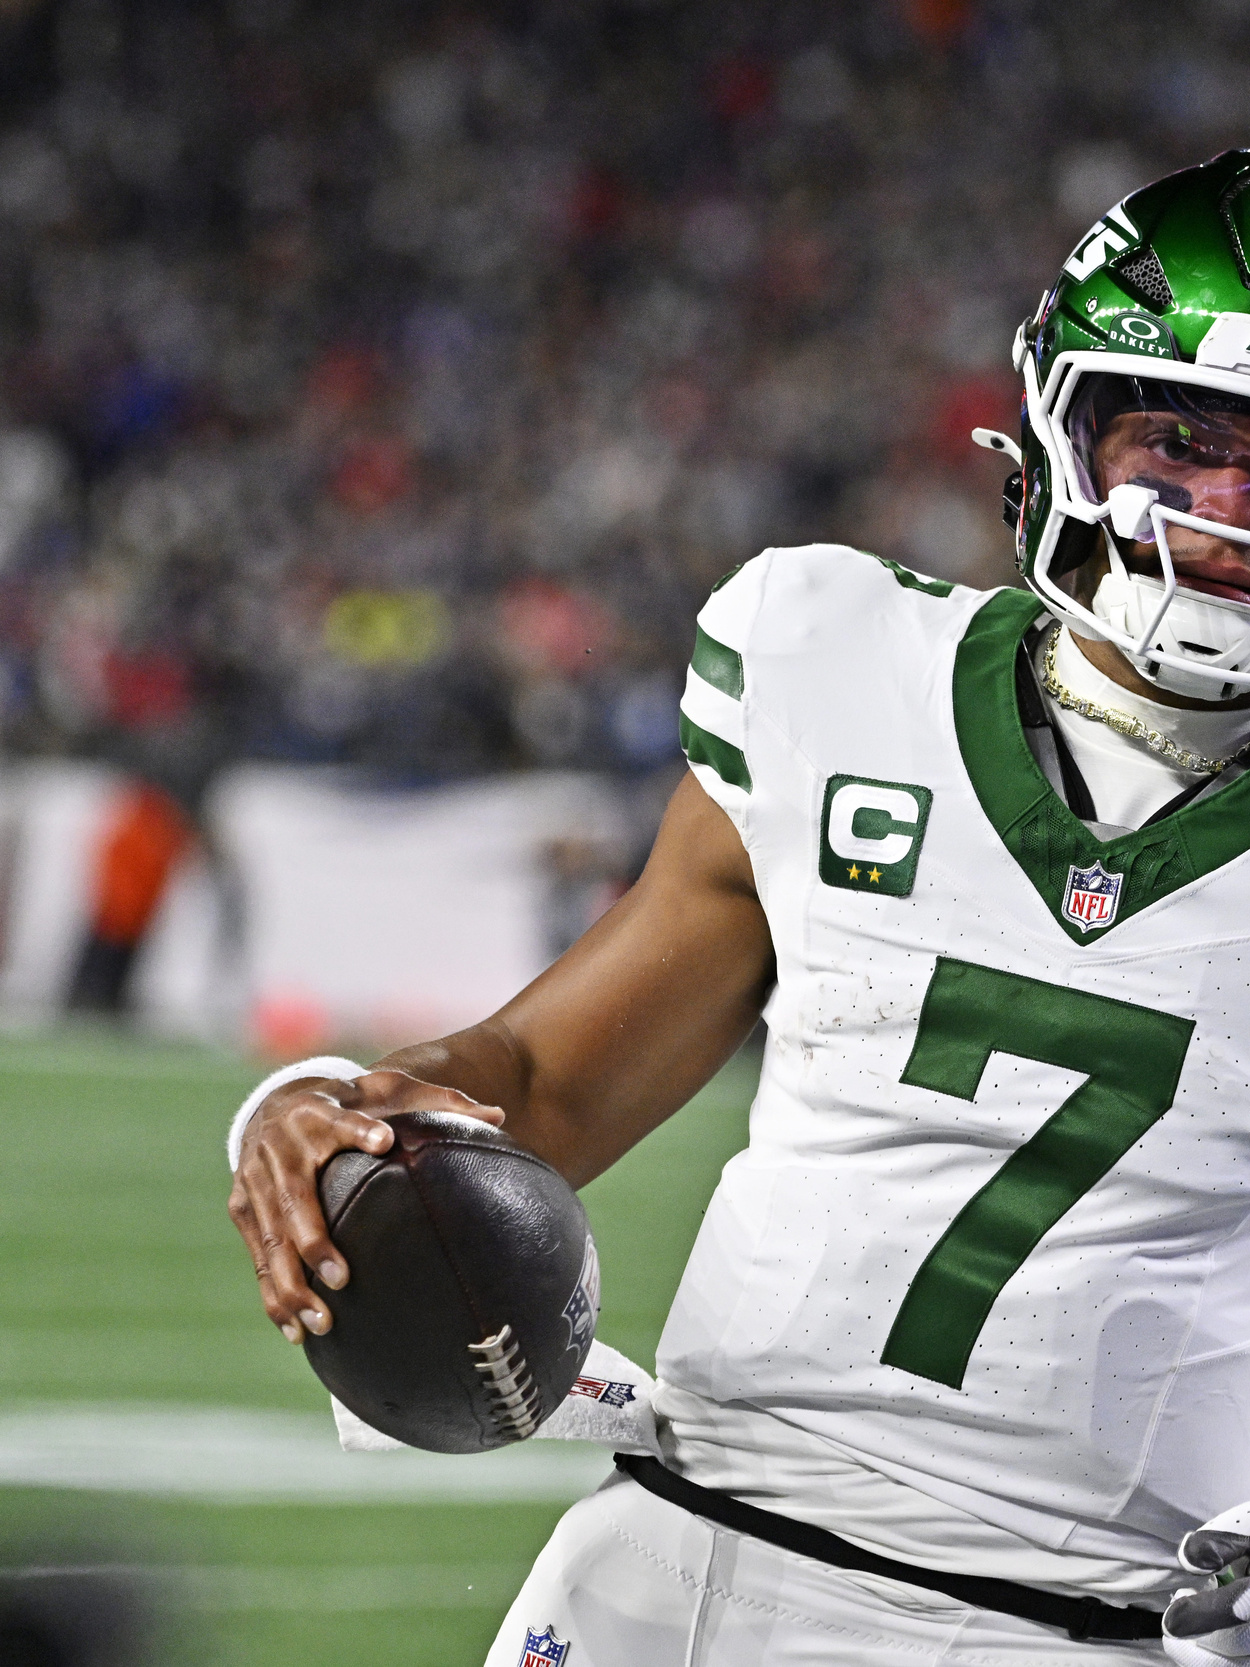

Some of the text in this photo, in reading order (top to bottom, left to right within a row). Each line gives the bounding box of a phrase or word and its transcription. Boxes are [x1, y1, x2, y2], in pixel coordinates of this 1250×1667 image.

[1109, 330, 1167, 356] OAKLEY
[828, 783, 919, 865] C
[1070, 891, 1109, 921] NFL
[879, 955, 1197, 1391] 7
